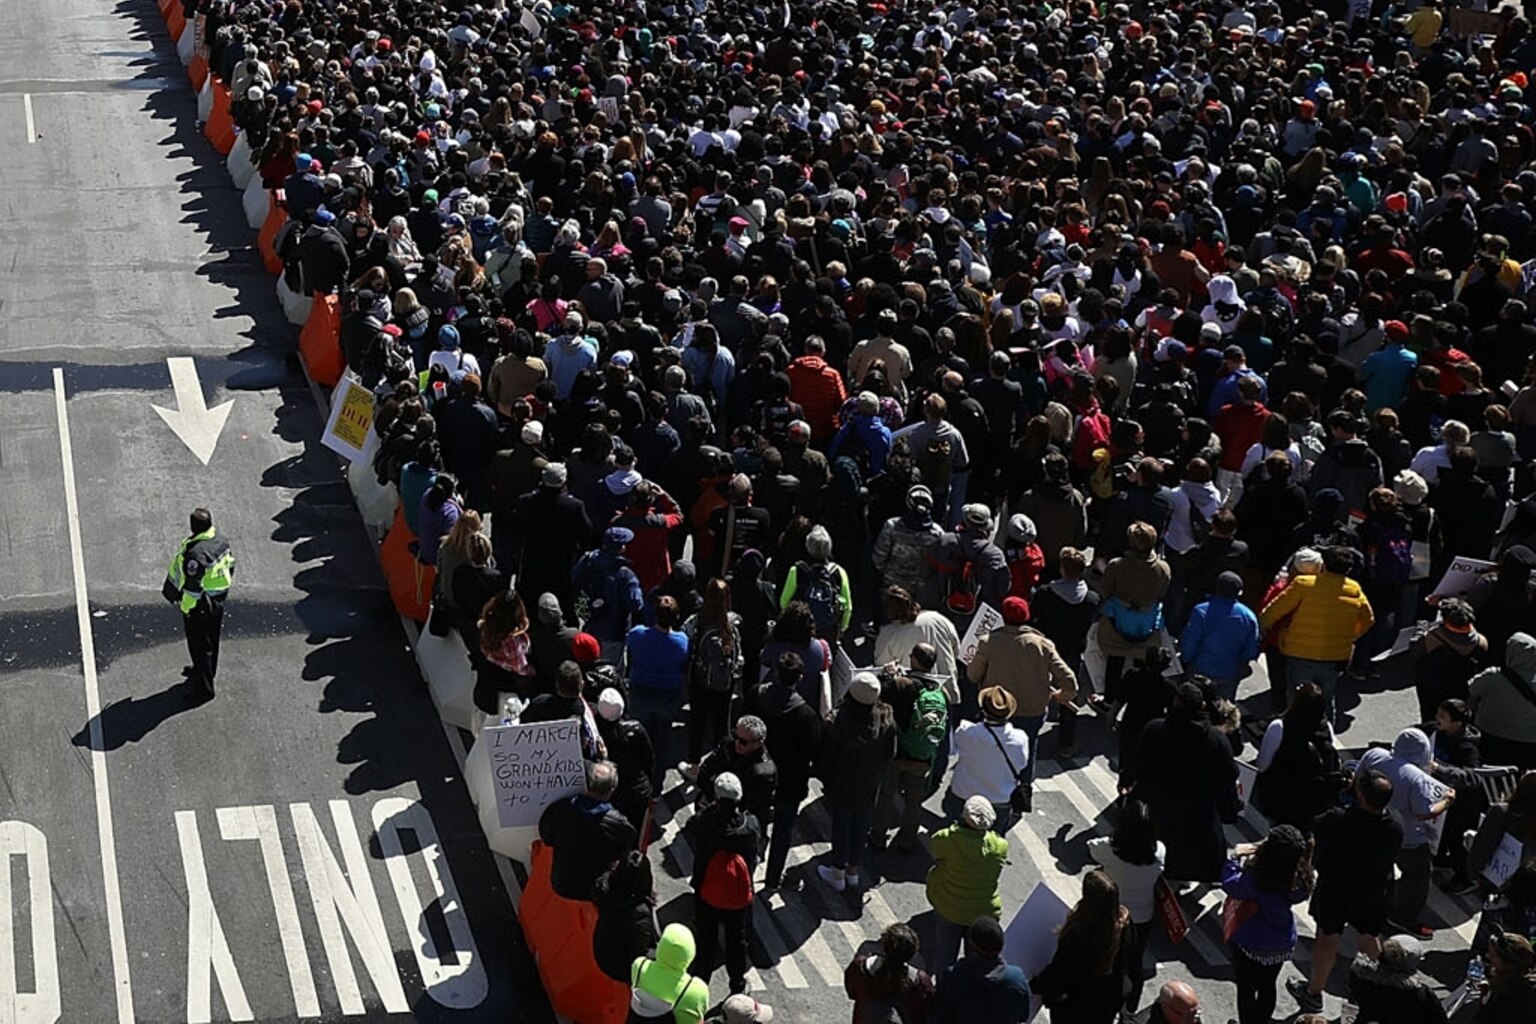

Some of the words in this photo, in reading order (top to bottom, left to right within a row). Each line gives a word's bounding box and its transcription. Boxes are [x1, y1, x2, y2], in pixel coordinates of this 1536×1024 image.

[493, 731, 504, 748] I
[514, 726, 578, 746] MARCH
[530, 748, 558, 761] MY
[546, 774, 584, 789] HAVE
[175, 797, 488, 1024] ONLY
